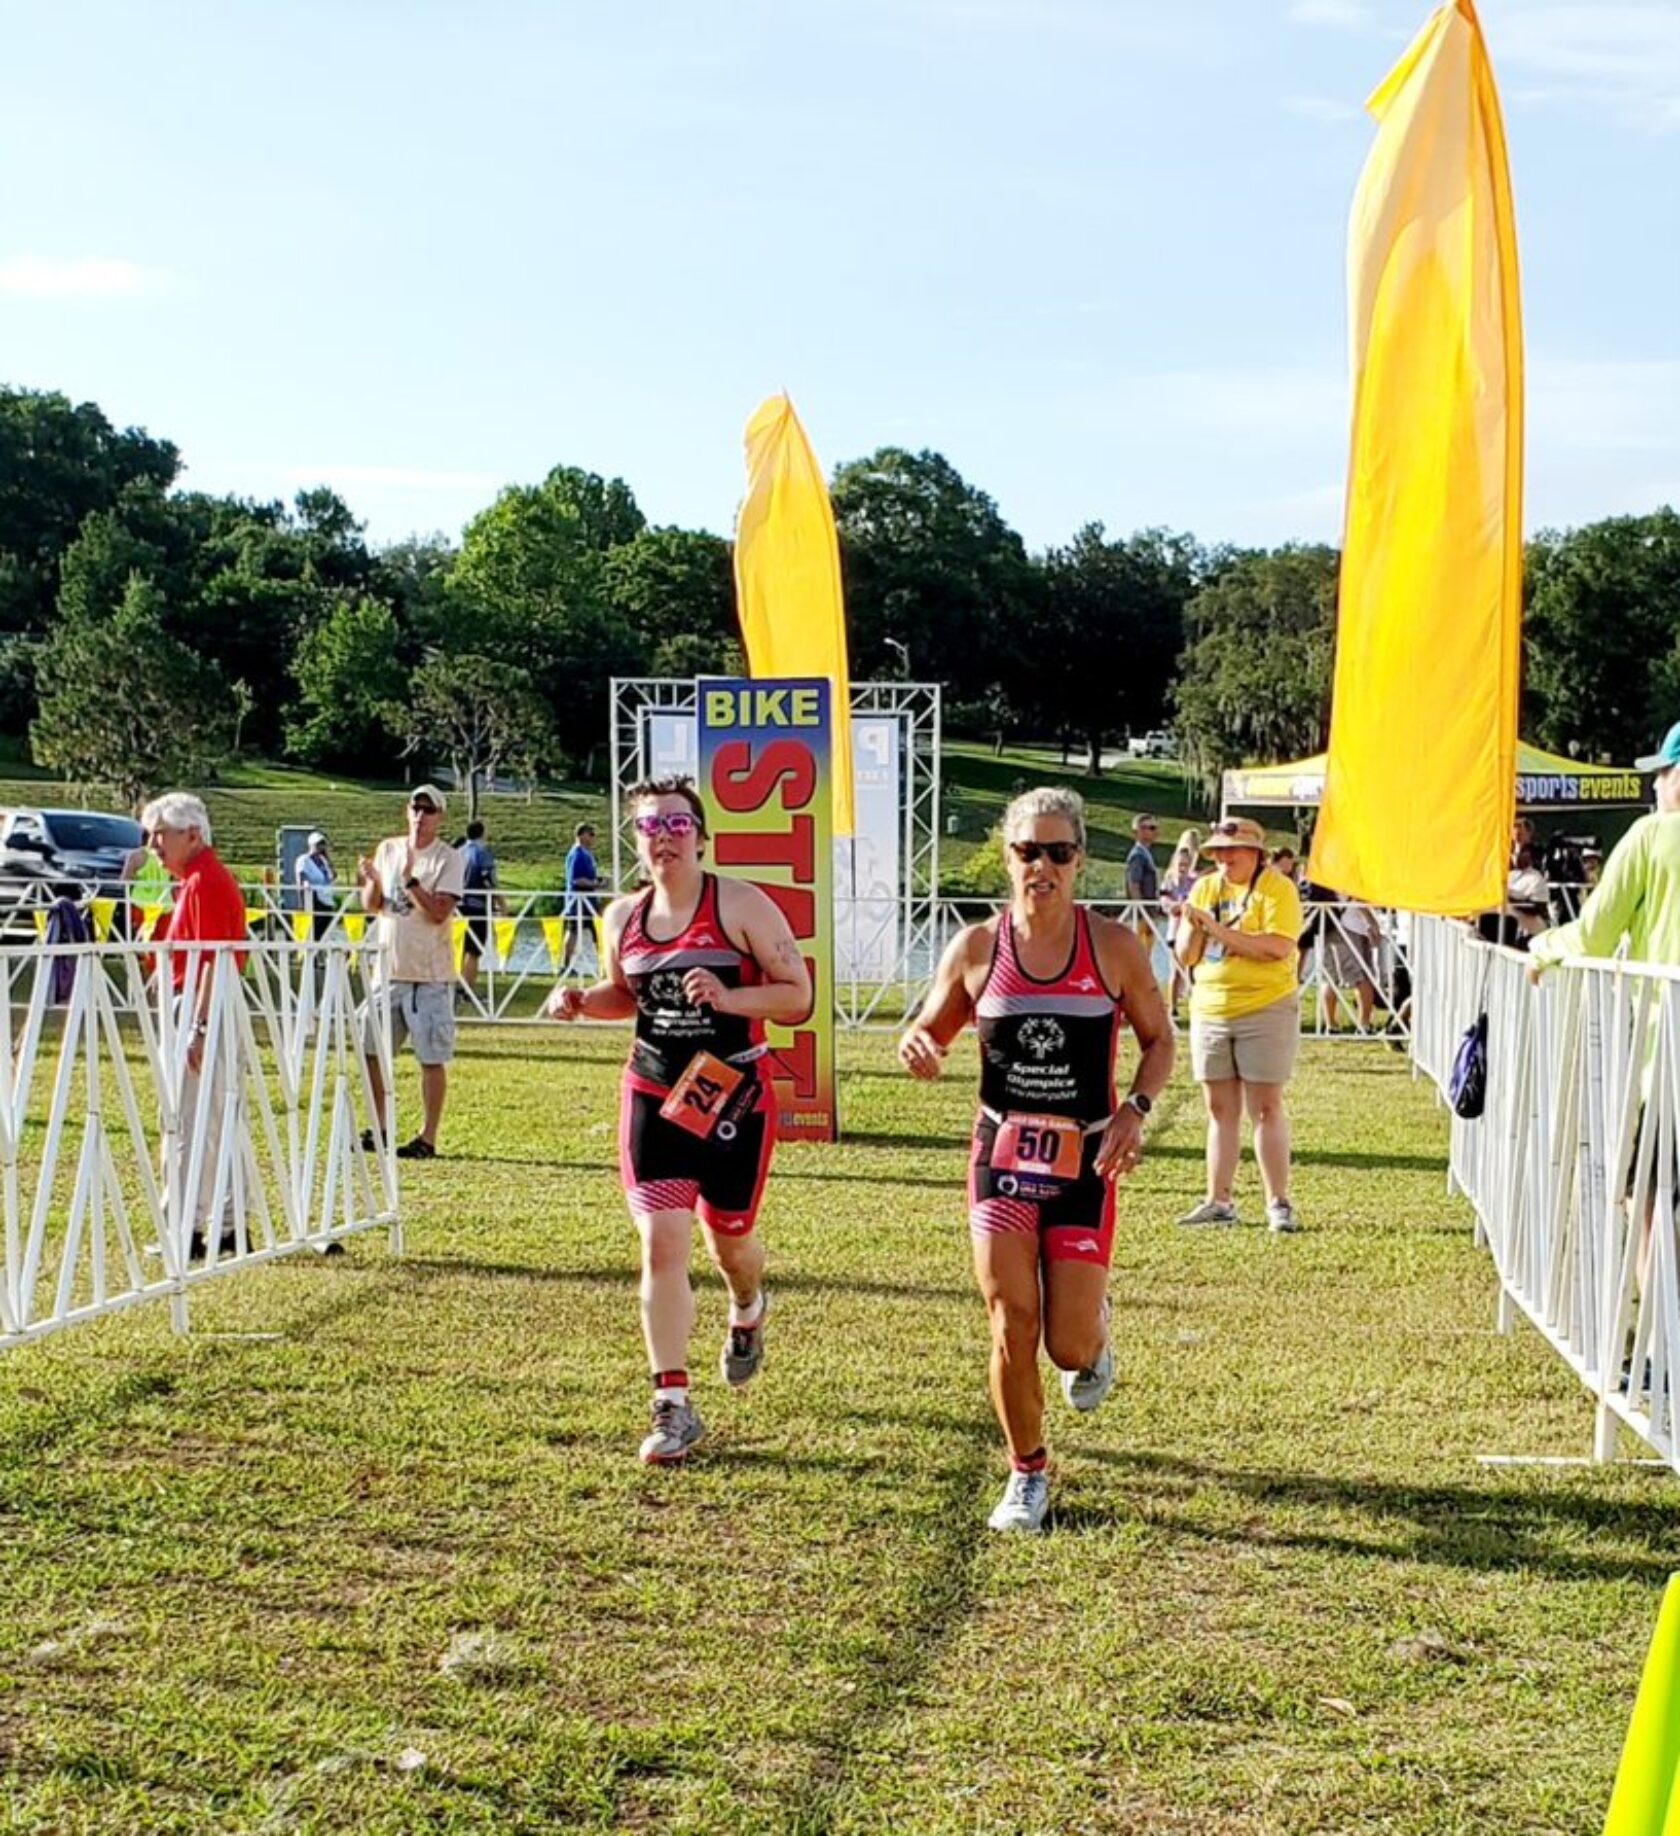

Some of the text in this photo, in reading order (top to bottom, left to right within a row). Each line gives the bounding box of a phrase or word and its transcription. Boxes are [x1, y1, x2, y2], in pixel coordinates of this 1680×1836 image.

[705, 689, 820, 728] BIKE
[712, 740, 817, 1097] STT
[1011, 1061, 1071, 1076] Special
[683, 1074, 723, 1117] 24
[1016, 1126, 1061, 1163] 50
